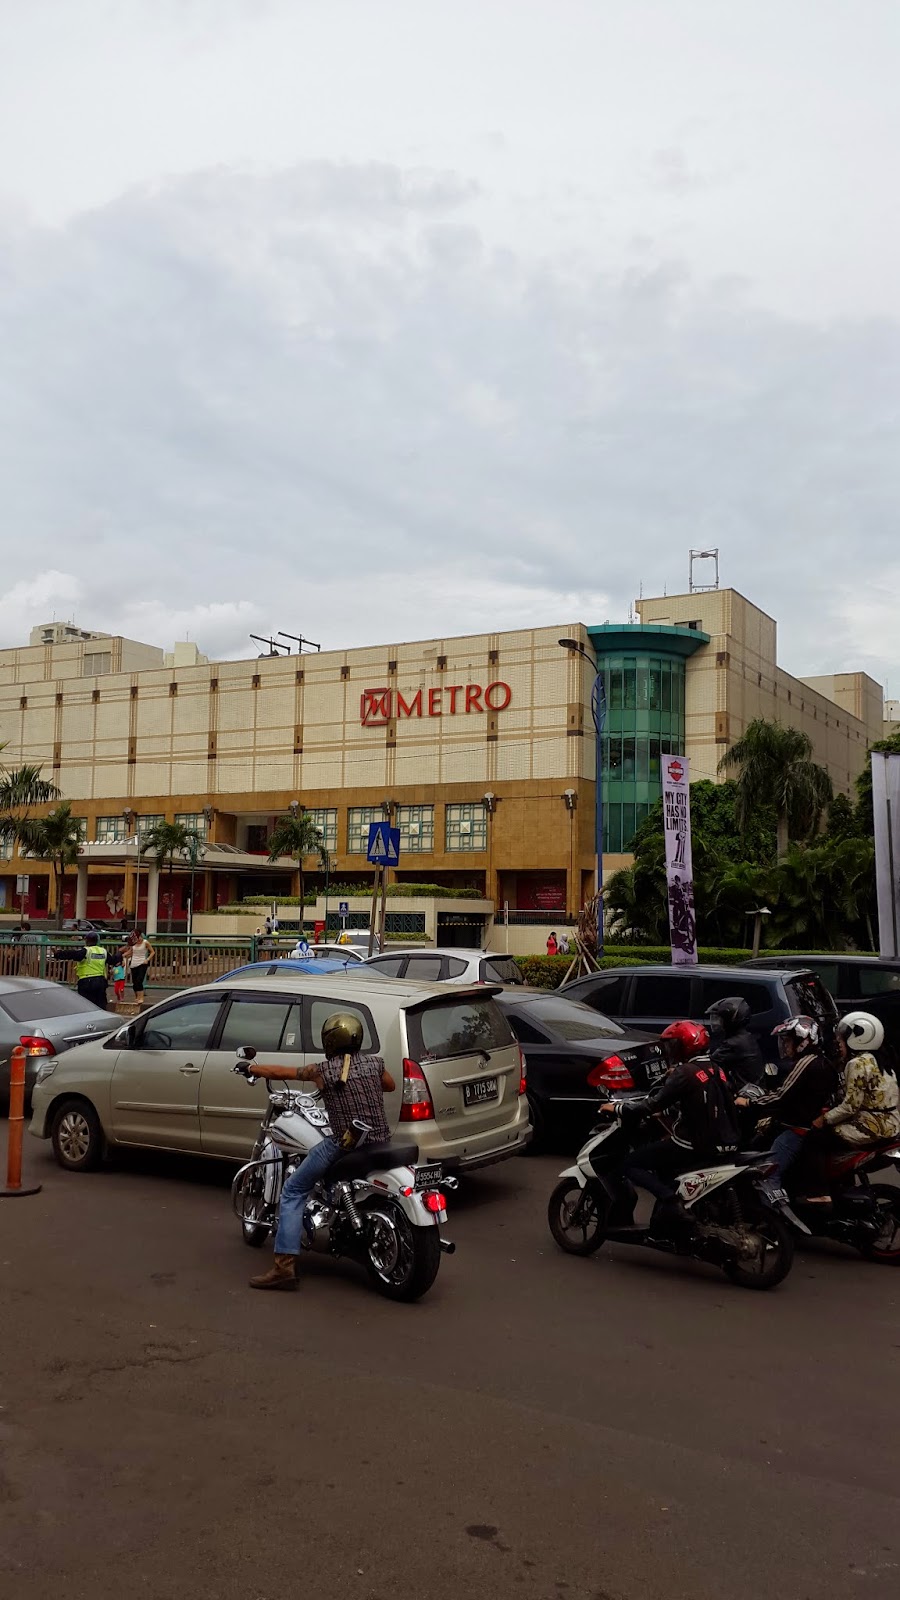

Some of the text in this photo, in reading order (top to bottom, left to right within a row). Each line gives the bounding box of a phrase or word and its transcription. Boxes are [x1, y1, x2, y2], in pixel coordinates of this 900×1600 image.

[397, 681, 512, 717] METRO
[665, 791, 688, 805] MY CITY
[666, 804, 687, 818] HAS NO
[465, 1085, 471, 1098] B
